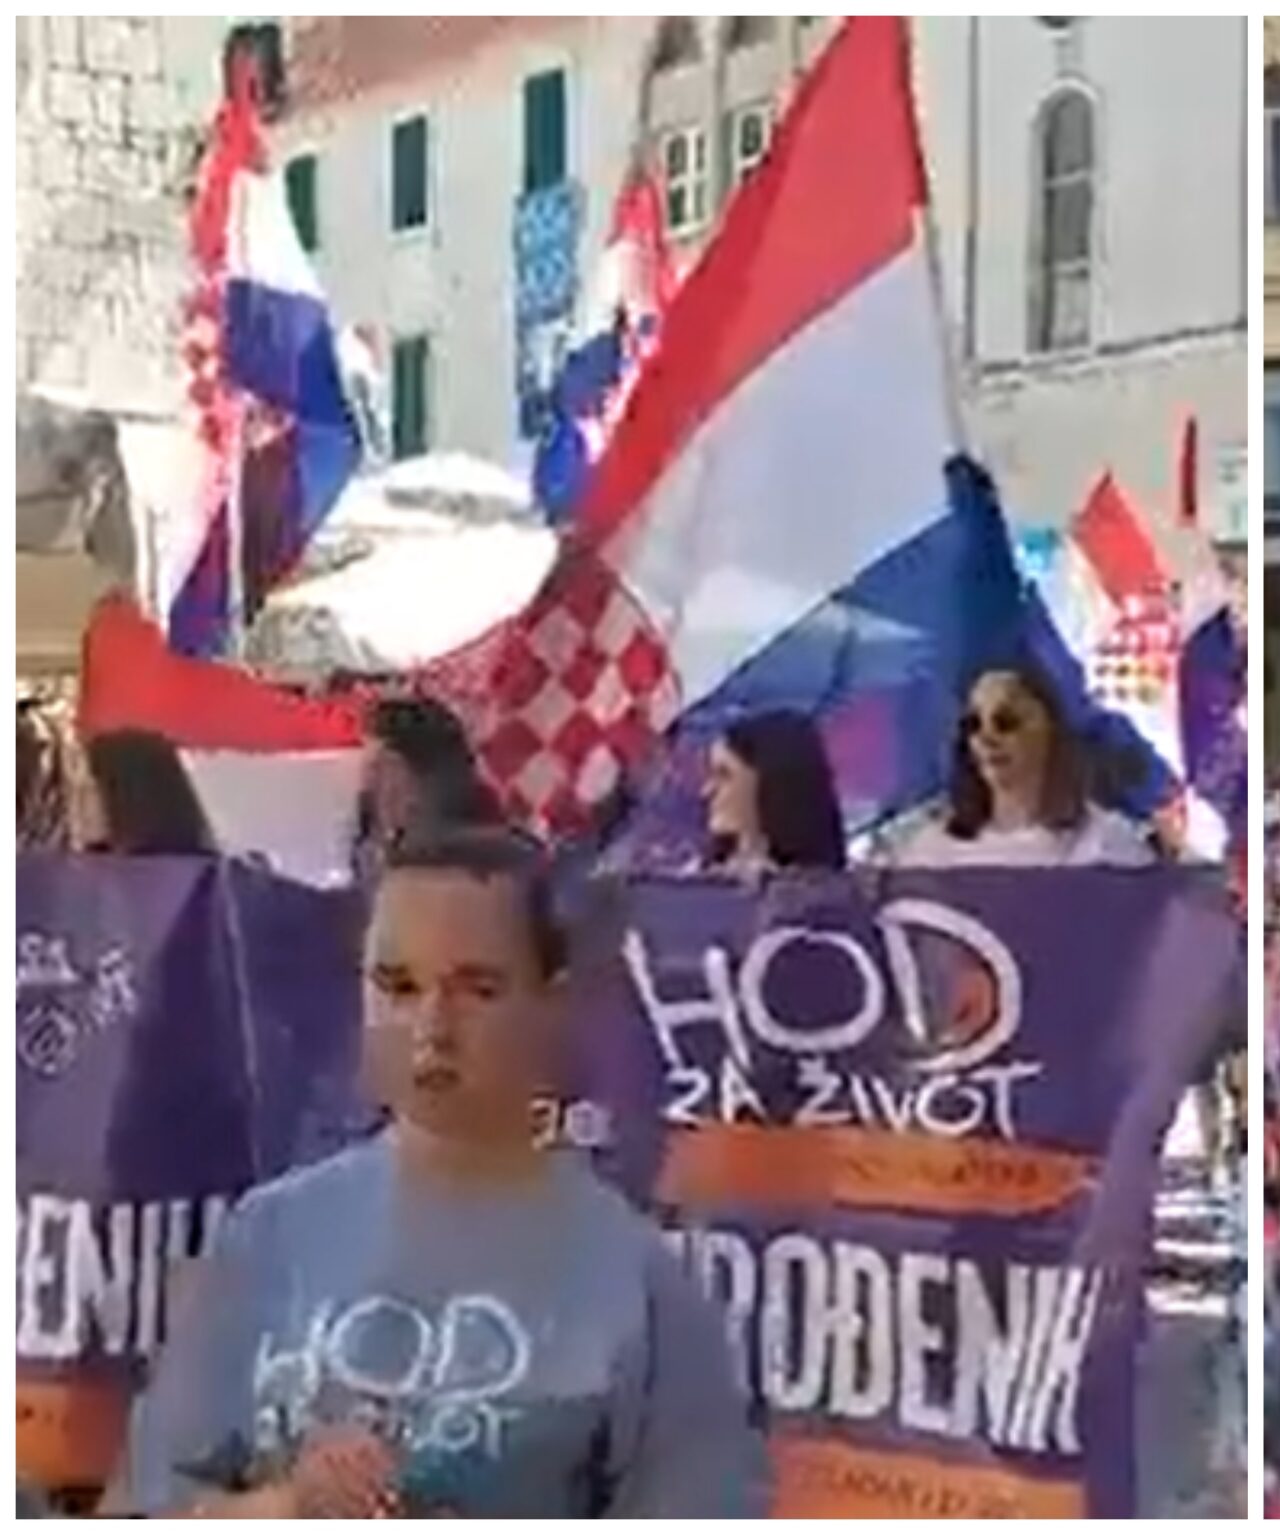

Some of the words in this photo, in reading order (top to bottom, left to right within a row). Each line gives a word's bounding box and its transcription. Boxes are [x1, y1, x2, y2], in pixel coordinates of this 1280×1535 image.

[622, 898, 1022, 1070] HOD
[660, 1057, 766, 1125] ZA
[794, 1056, 1044, 1142] ŽIVOT
[253, 1296, 530, 1402] HOD
